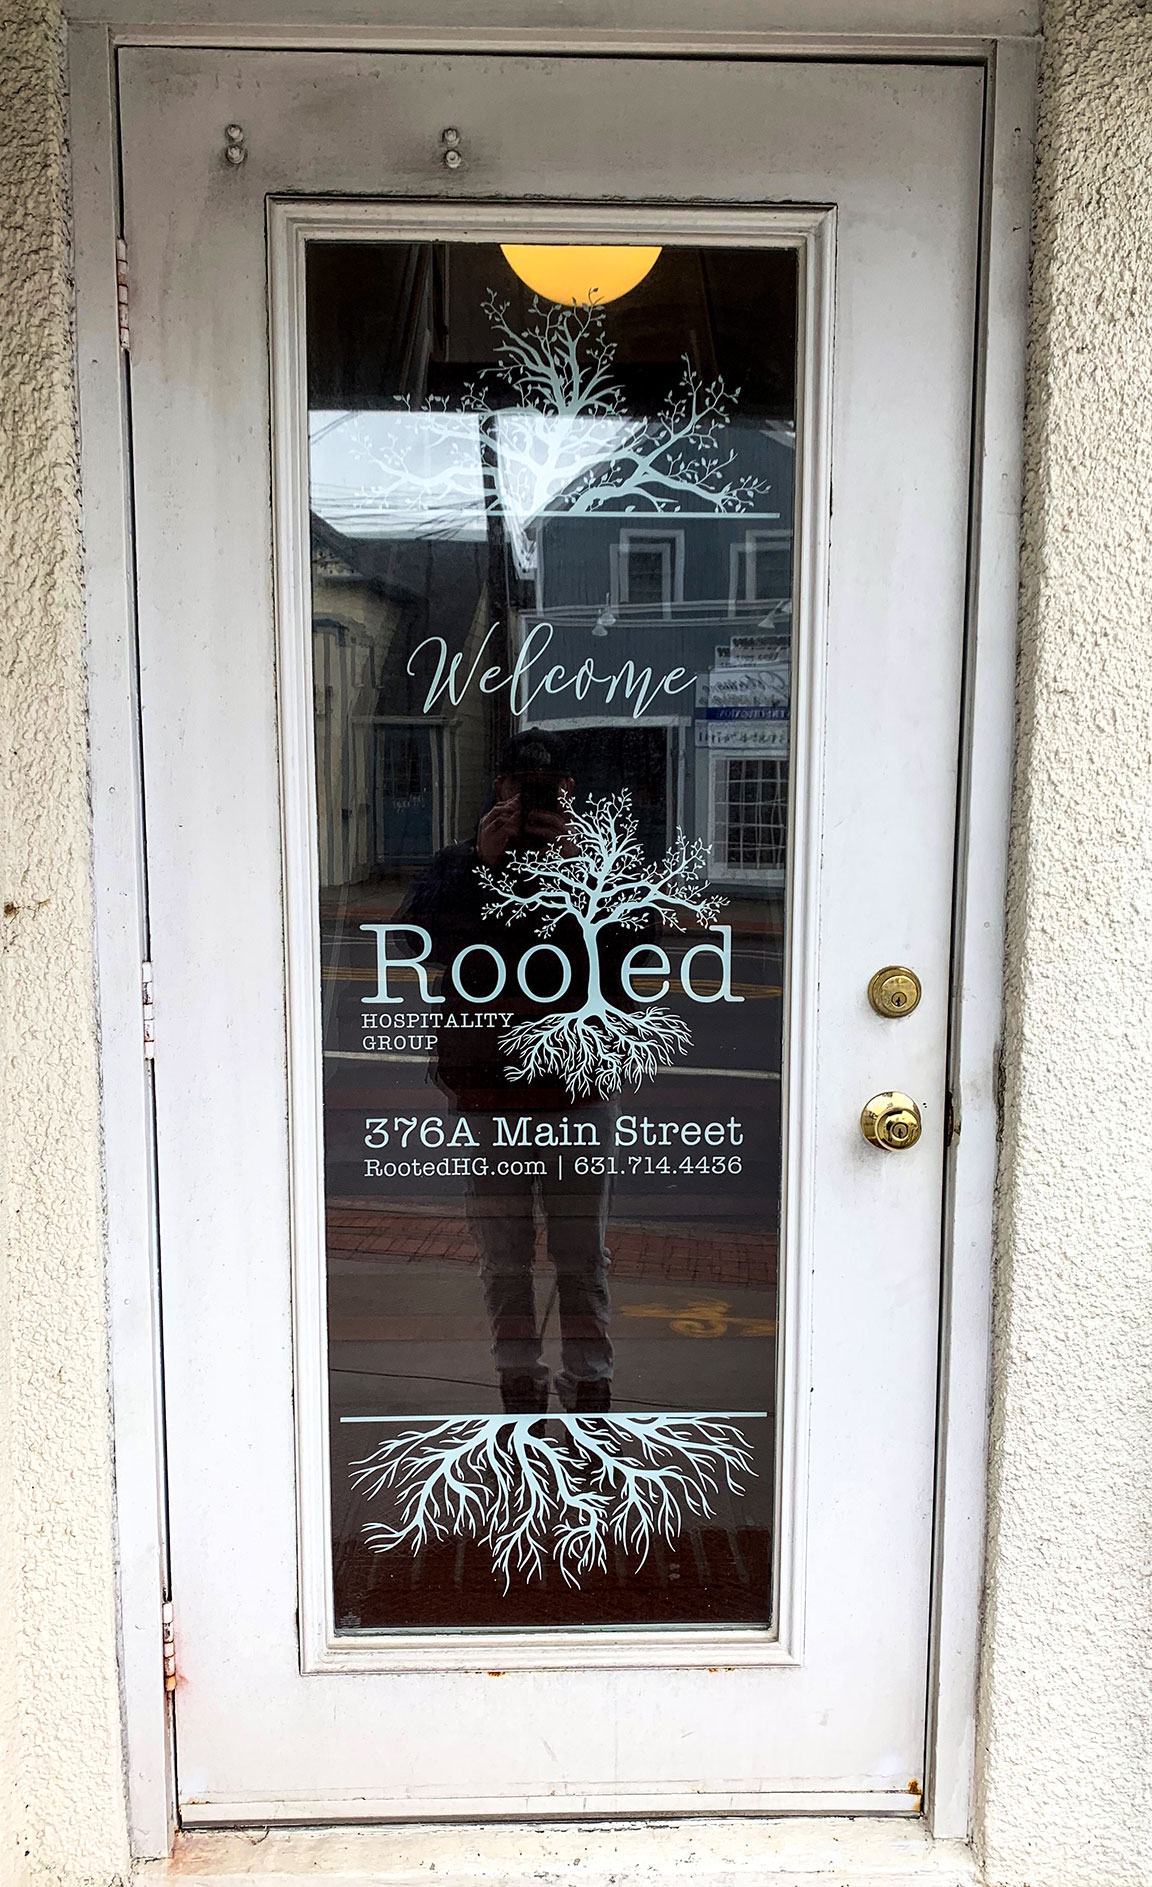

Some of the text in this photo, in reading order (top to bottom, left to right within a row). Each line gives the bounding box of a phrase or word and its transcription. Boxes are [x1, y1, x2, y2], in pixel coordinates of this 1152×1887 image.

[406, 621, 697, 719] Welcome
[359, 923, 746, 1004] Rooted
[361, 1012, 514, 1030] HOSPITALITY
[362, 1035, 439, 1051] GROUP
[364, 1115, 744, 1149] 376A Main Street
[363, 1157, 548, 1178] RootedHG.com
[573, 1155, 742, 1176] 631.714.4436
